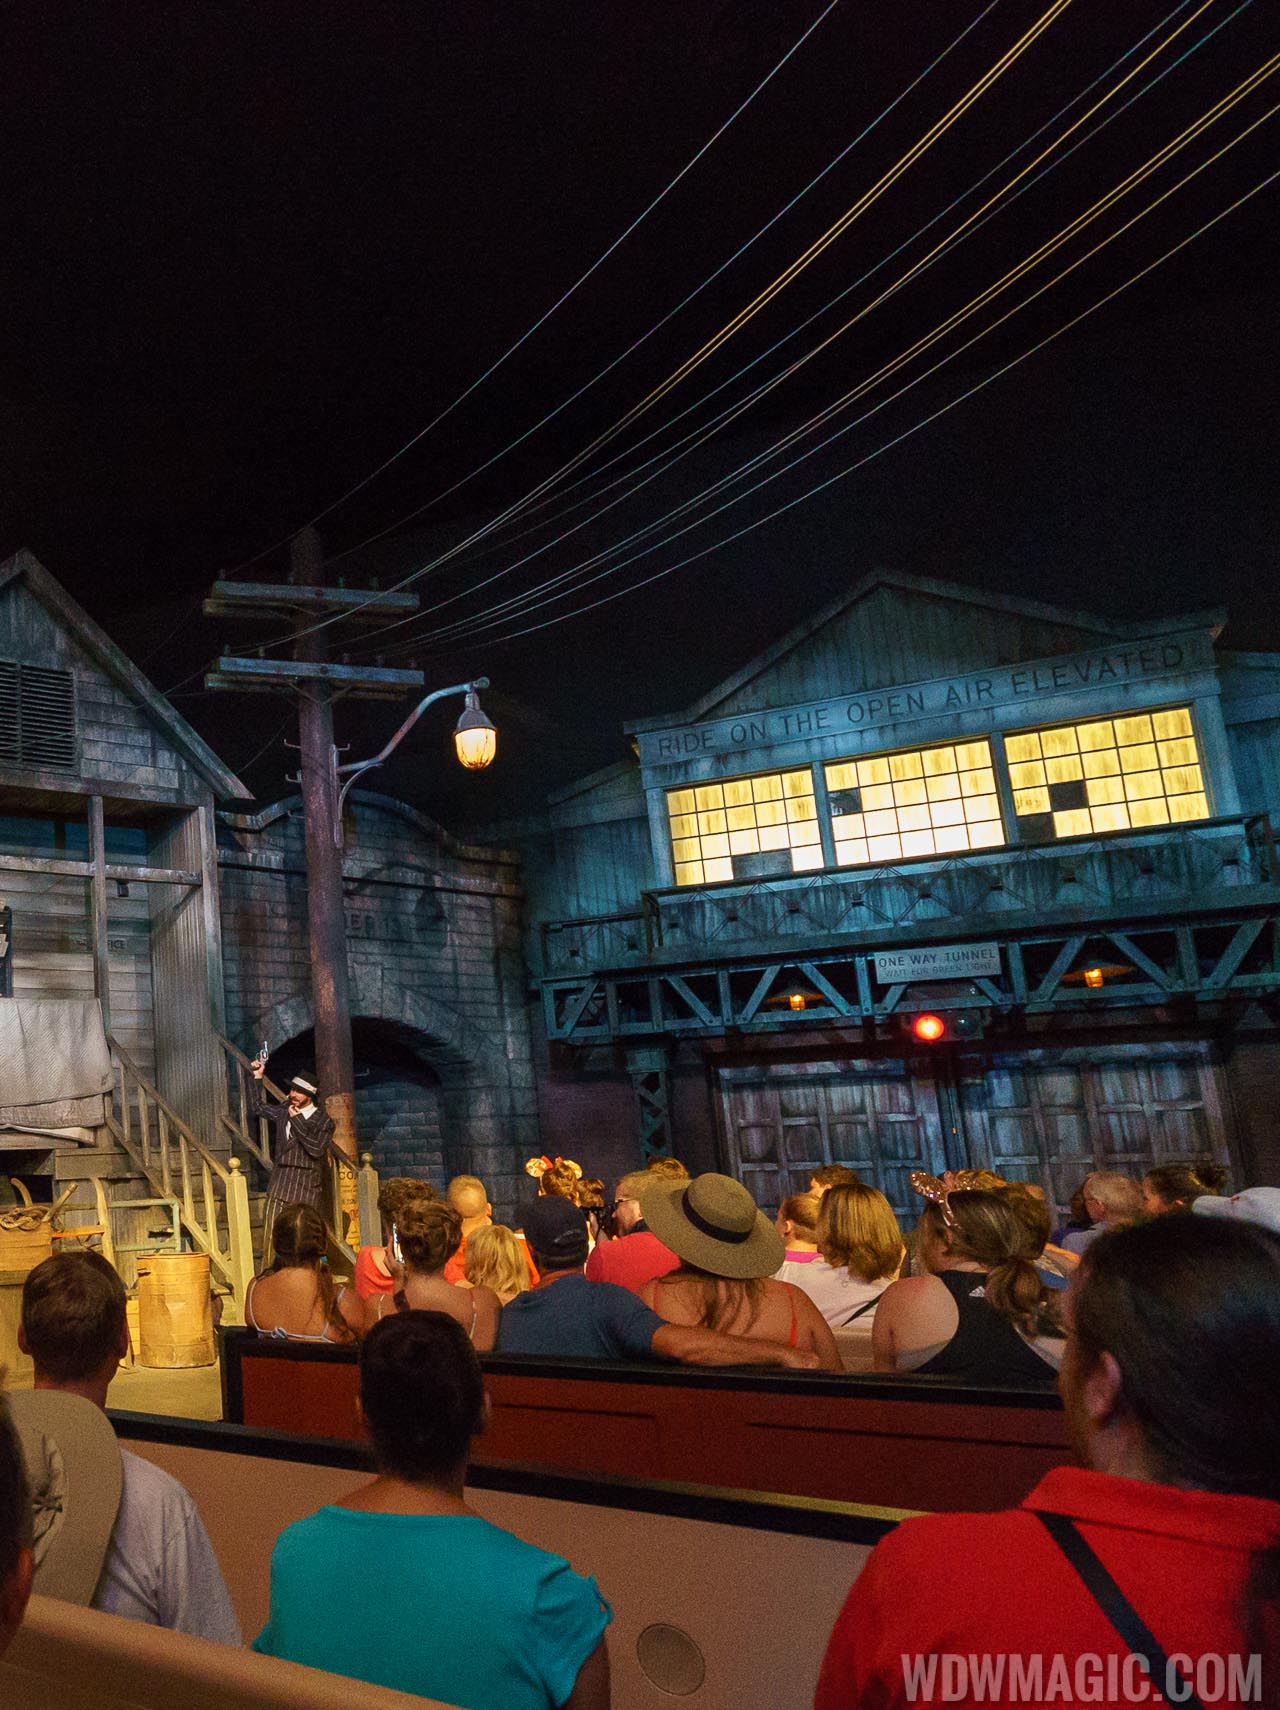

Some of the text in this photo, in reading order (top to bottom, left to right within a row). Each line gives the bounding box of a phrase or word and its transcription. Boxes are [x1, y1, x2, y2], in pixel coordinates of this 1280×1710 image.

[658, 643, 1184, 757] RIDE ON THE OPEN AIR ELEVATED
[879, 948, 996, 968] ONE WAY TUNNEL
